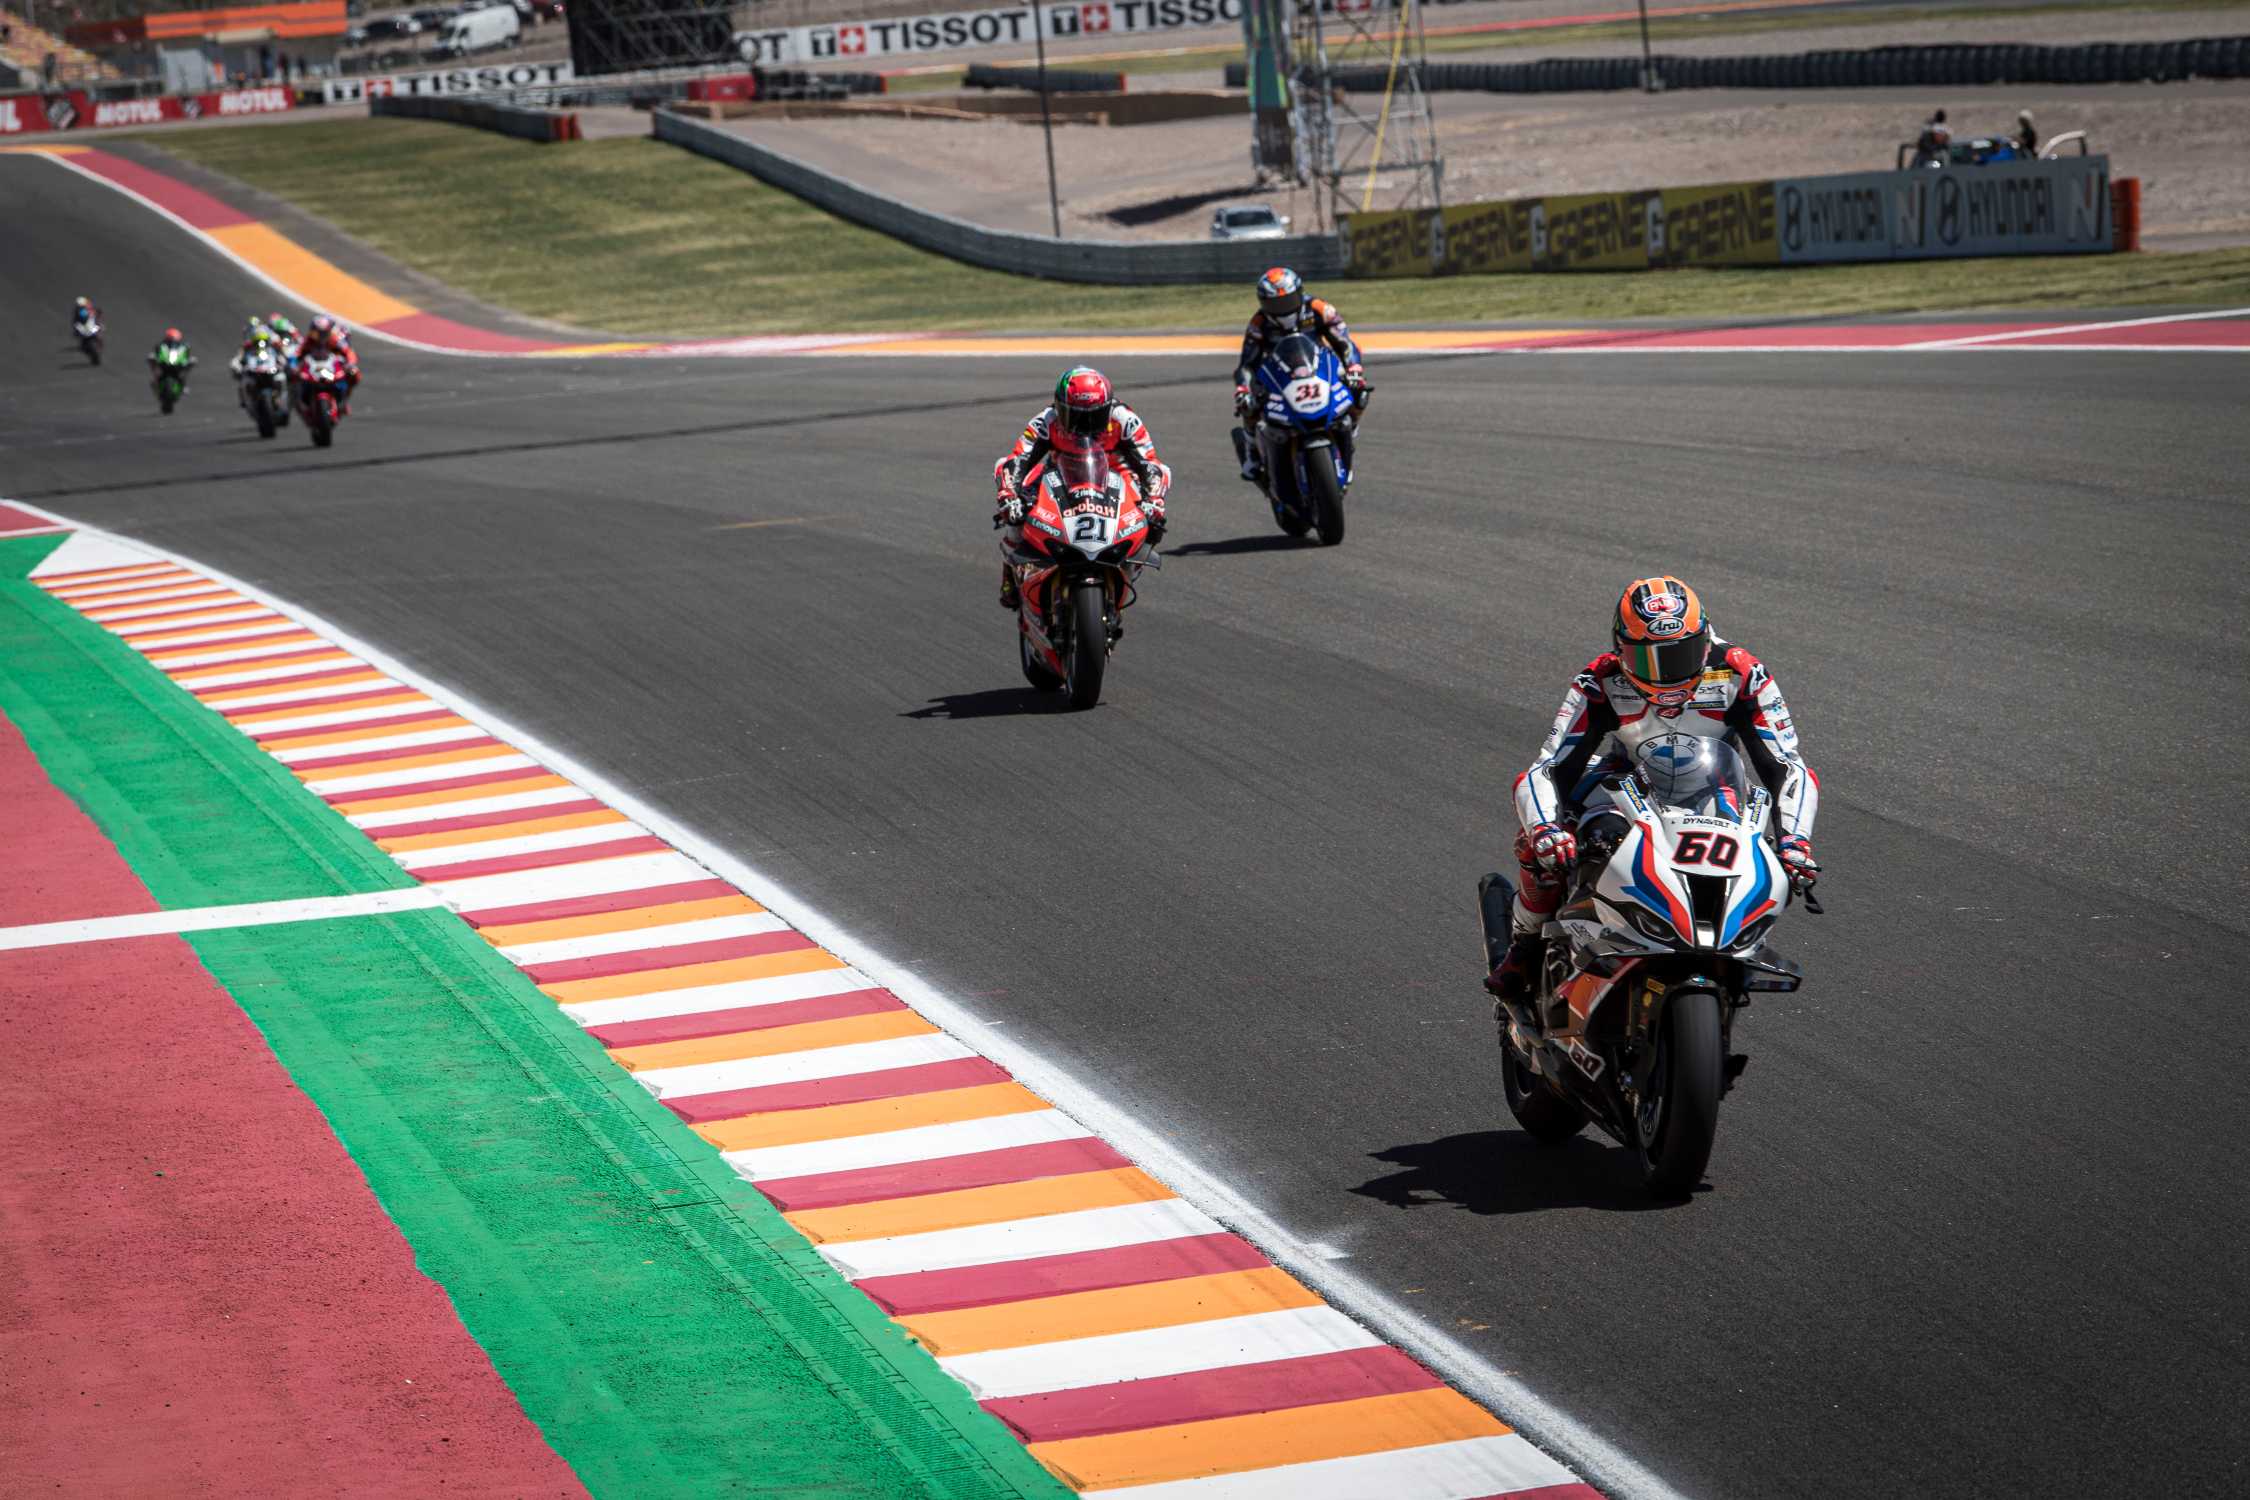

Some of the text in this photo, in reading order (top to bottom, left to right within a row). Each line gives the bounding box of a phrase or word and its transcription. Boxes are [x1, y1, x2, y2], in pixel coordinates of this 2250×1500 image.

[1115, 0, 1243, 28] TISSO
[871, 11, 1028, 50] TISSOT
[398, 63, 568, 94] TISSOT
[95, 98, 163, 125] MOTUL
[218, 88, 288, 115] MOTUL
[1445, 203, 1530, 270] GAERNE
[1547, 194, 1648, 265] GAERNE
[1665, 183, 1776, 262] GAERNE
[1295, 383, 1321, 402] 31
[1063, 498, 1115, 519] aruba.it
[1031, 518, 1062, 537] Lenovo
[1074, 516, 1108, 543] 21
[1118, 520, 1146, 538] Lenovo
[1654, 621, 1680, 632] Arai
[1645, 735, 1697, 749] BMW
[1682, 817, 1731, 830] DYNAVOLT
[1671, 831, 1740, 870] 60
